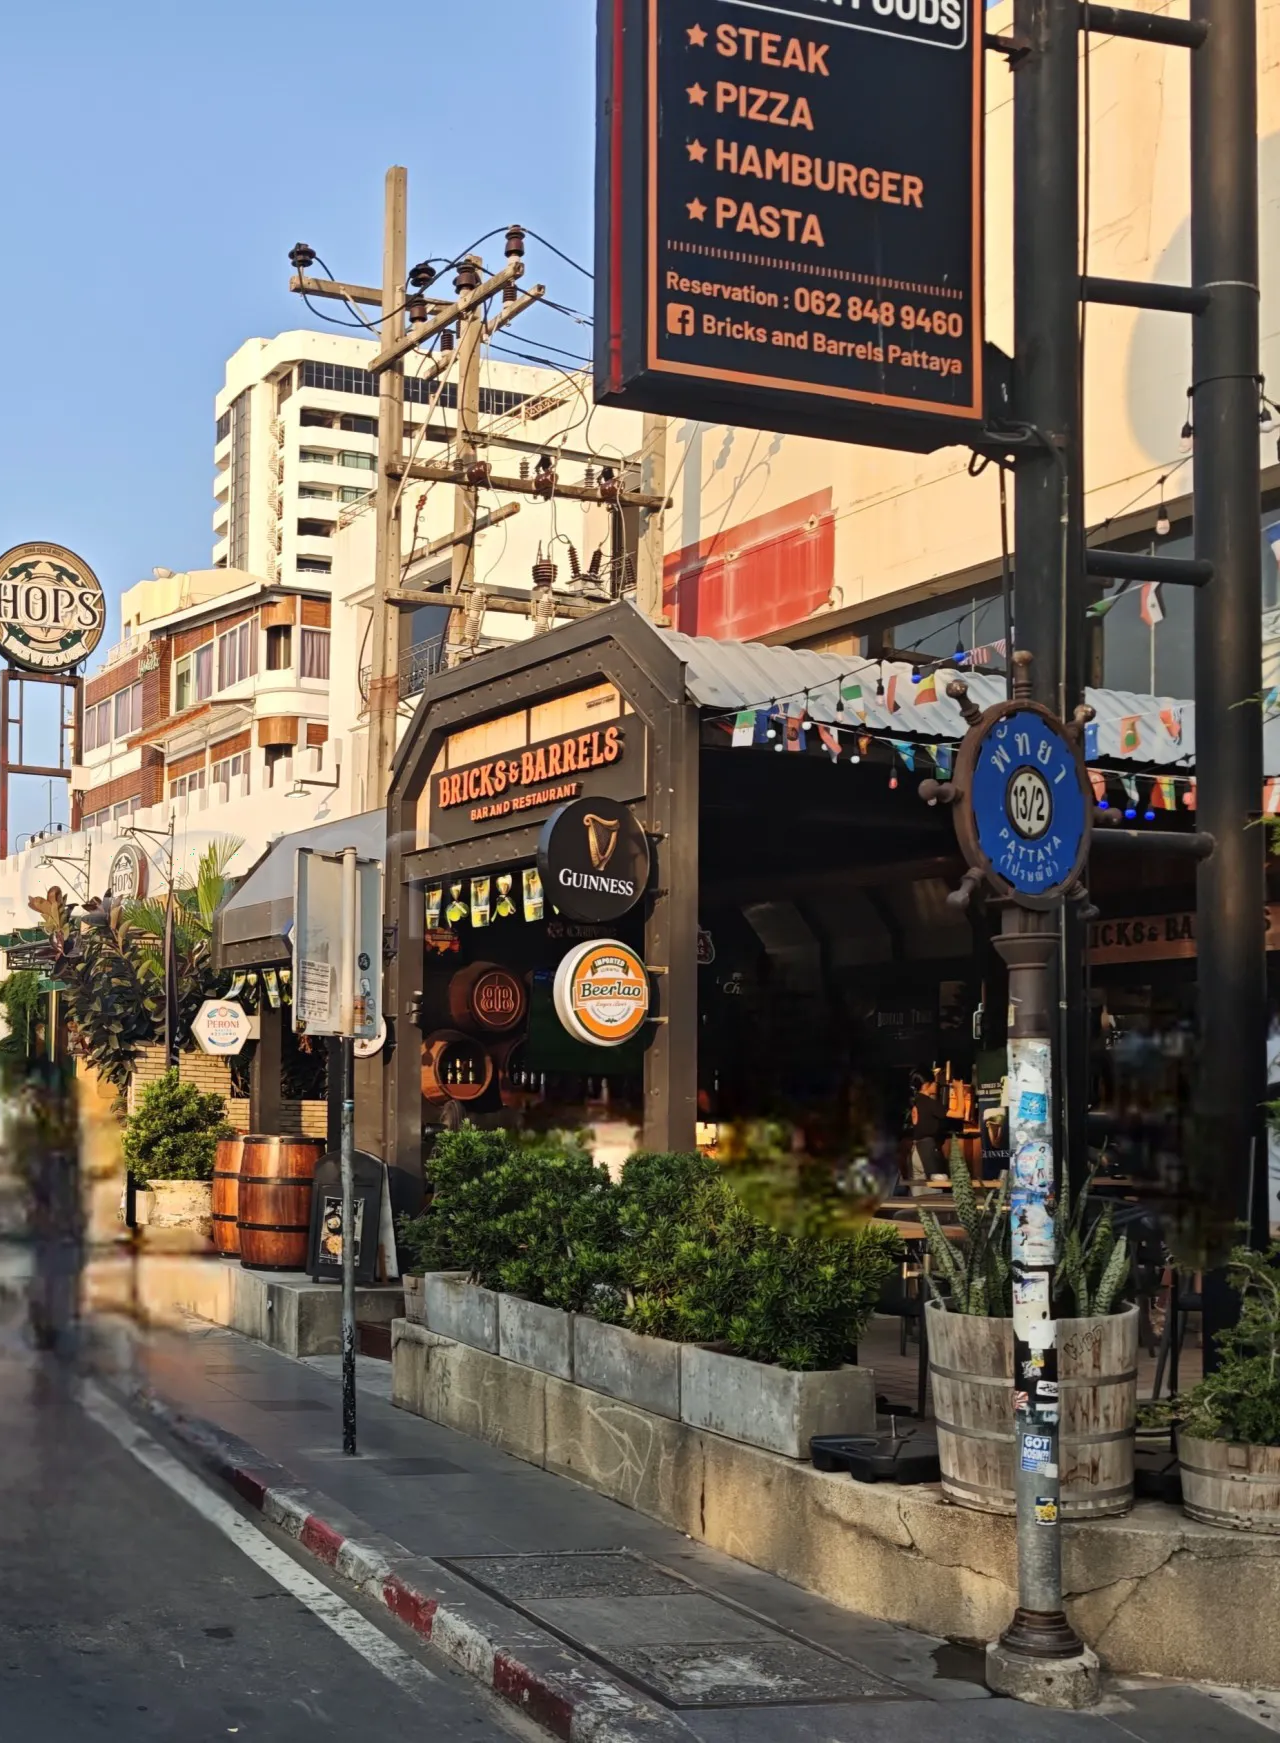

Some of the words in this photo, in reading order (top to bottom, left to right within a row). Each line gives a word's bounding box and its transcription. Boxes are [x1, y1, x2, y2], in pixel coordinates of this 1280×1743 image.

[716, 24, 830, 76] STEAK
[716, 81, 815, 131] PIZZA
[716, 138, 924, 208] HAMBURGER
[716, 197, 825, 247] PASTA
[666, 271, 778, 307] Reservation
[794, 287, 842, 319] 062
[847, 296, 895, 327] 848
[900, 305, 963, 338] 9460
[702, 314, 768, 343] Bricks
[771, 330, 808, 350] and
[813, 333, 884, 363] Barrels
[888, 344, 963, 377] Pattaya
[438, 760, 507, 808] BRICKS
[521, 726, 619, 785] BARRELS
[991, 716, 1067, 784] พัทยา
[470, 806, 489, 821] BAR
[489, 800, 510, 817] AND
[512, 782, 578, 811] RESTAURANT
[1014, 785, 1045, 821] 13/2
[999, 827, 1062, 862] PATTAYA
[111, 872, 133, 892] HOPS
[559, 868, 634, 896] GUINNESS
[1089, 921, 1145, 948] ICKS
[594, 957, 626, 967] IMPORTED
[581, 981, 641, 997] Beerlao
[207, 1020, 239, 1028] PERONI
[1024, 1436, 1050, 1450] GOT
